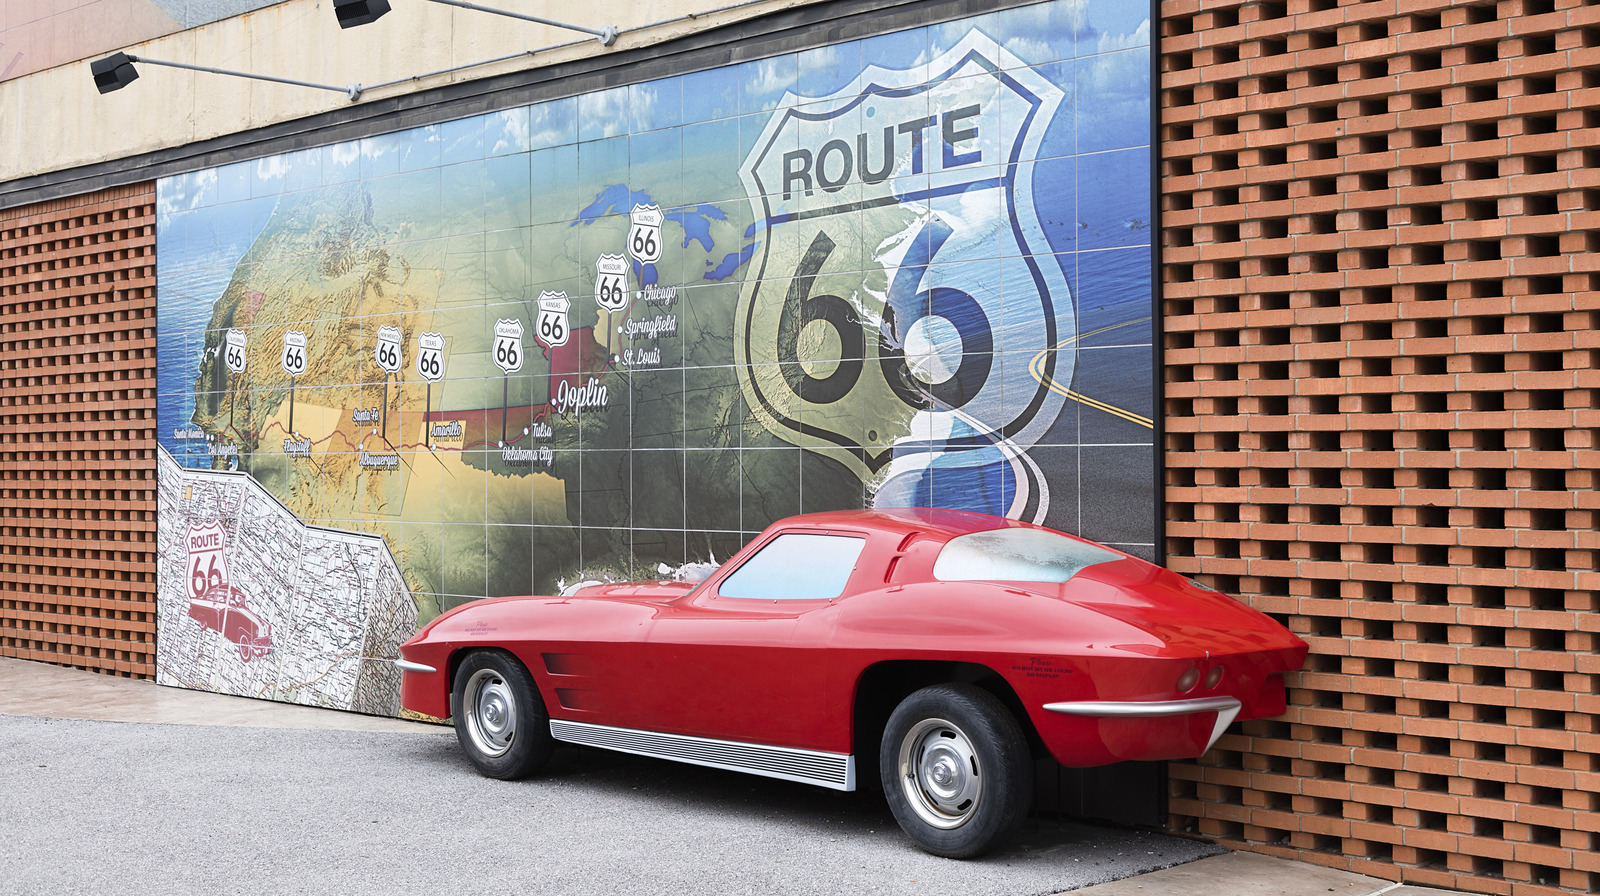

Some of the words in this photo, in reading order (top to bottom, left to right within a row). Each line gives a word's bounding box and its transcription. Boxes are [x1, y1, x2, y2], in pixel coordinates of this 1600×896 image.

[782, 103, 982, 201] ROUTE
[638, 214, 655, 223] ILLINOIS
[633, 227, 656, 257] 66
[602, 263, 622, 271] MISSOURI
[600, 276, 623, 304] 66
[643, 283, 677, 305] Chicago
[545, 301, 561, 309] KANSAS
[777, 213, 994, 413] 66
[498, 327, 519, 335] OKLAHOMA
[541, 313, 563, 340] 66
[625, 314, 677, 340] Springfield
[424, 339, 437, 347] TEXAS
[496, 339, 517, 366] 66
[227, 346, 242, 368] 66
[285, 347, 303, 369] 66
[379, 342, 397, 367] 66
[420, 350, 440, 375] 66
[622, 349, 635, 366] St.
[636, 347, 660, 365] Louis
[557, 376, 609, 416] Joplin
[352, 407, 370, 422] Santa
[371, 407, 379, 421] Fe
[431, 420, 462, 438] Amarillo
[532, 421, 552, 438] Tulsa
[283, 438, 311, 457] Flagstaff
[502, 446, 538, 461] Oklahoma
[539, 446, 554, 467] City
[359, 451, 399, 469] Albuquerque
[190, 533, 220, 549] ROUTE
[192, 554, 222, 597] 66
[1030, 657, 1052, 666] Please
